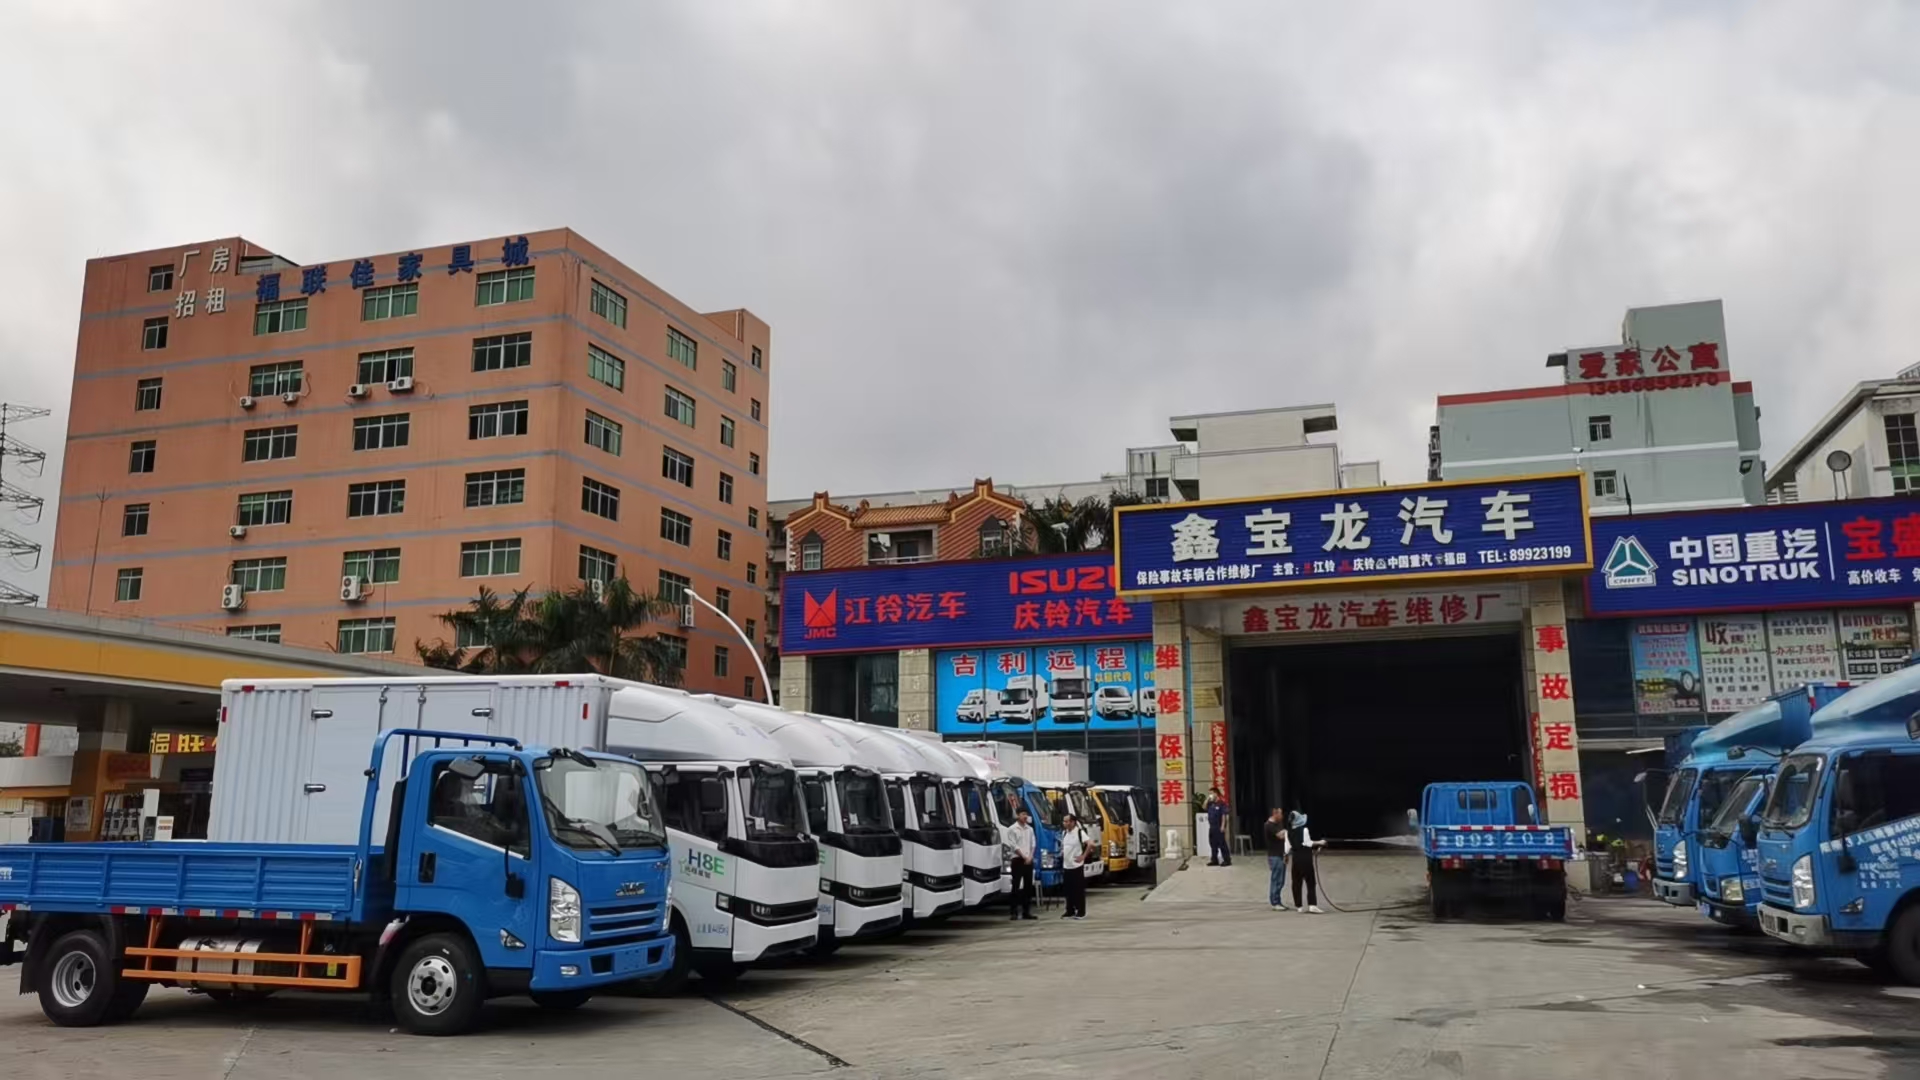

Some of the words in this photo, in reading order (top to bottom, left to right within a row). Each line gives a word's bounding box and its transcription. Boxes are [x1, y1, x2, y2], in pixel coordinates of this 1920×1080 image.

[178, 244, 231, 279] 厂房
[256, 235, 529, 303] 福联佳家具城
[174, 287, 227, 319] 招租
[1170, 490, 1534, 562] 鑫宝龙汽车
[1669, 527, 1819, 566] 中国重汽
[1009, 566, 1116, 595] ISUZ
[1136, 563, 1262, 585] 保险事故车辆合作维修厂
[1672, 561, 1820, 587] SINOTRUK
[1847, 568, 1902, 586] 高价收车
[845, 591, 966, 625] 江铃汽车
[1013, 599, 1133, 630] 庆铃汽车
[804, 627, 837, 640] JMC
[952, 647, 1128, 677] 吉利远程
[1155, 644, 1184, 805] 维修保养
[1536, 624, 1579, 801] 事故定损
[688, 848, 725, 876] H8E
